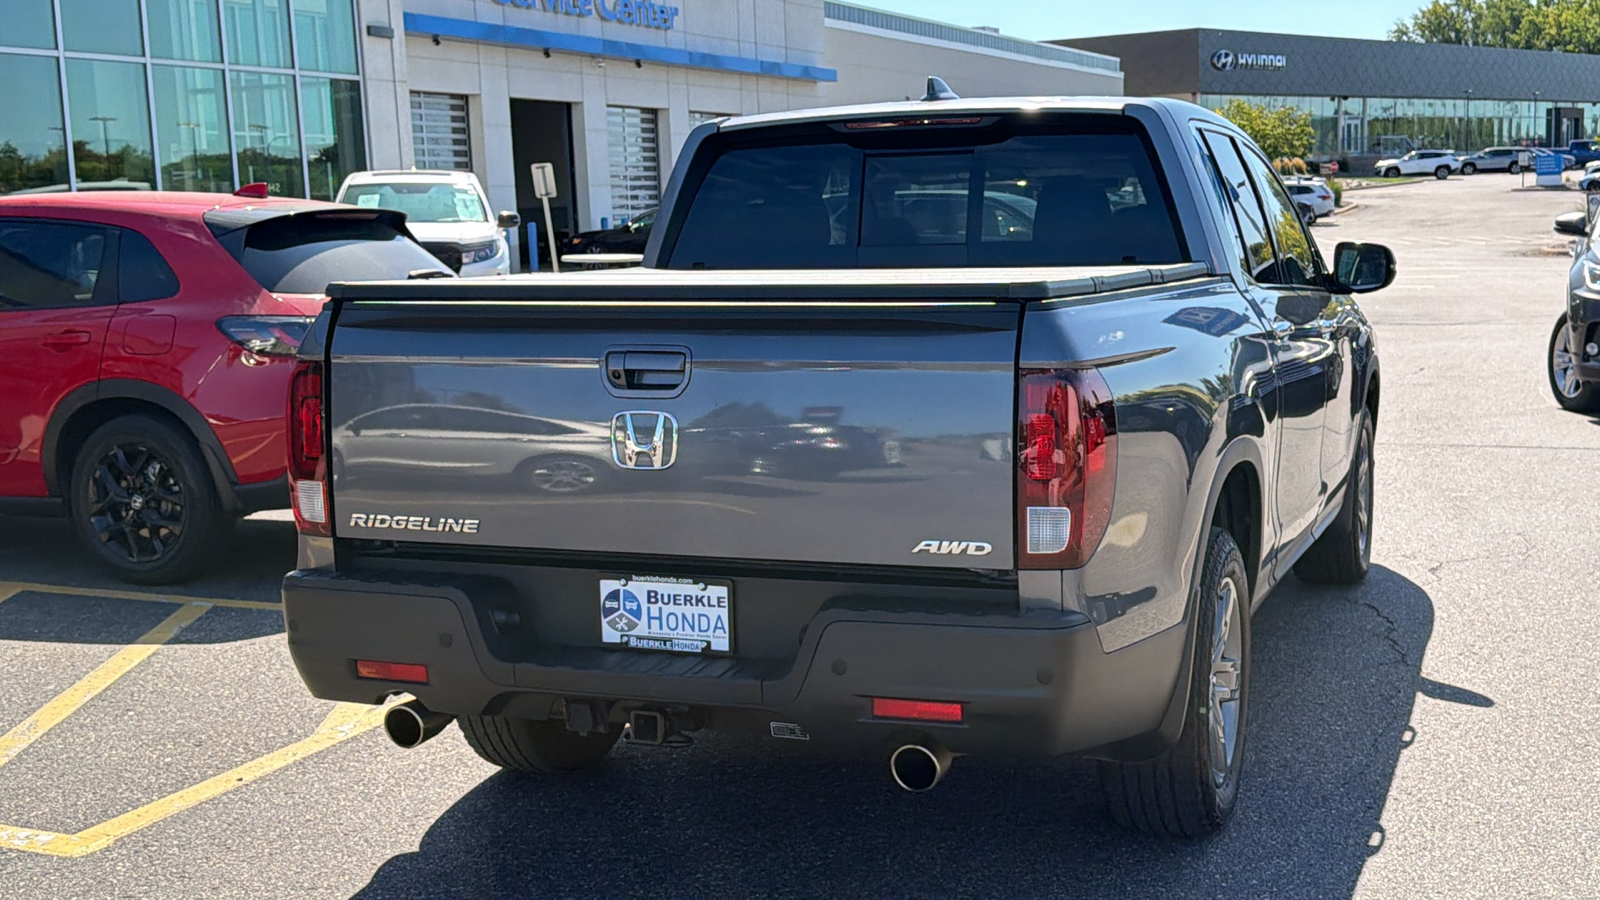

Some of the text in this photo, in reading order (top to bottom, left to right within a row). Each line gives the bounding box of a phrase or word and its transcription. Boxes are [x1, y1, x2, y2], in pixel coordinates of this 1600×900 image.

[600, 0, 679, 29] Center
[349, 513, 480, 533] RIDGELINE
[911, 540, 993, 556] AWD
[631, 574, 694, 584] buerklehonda.com
[646, 589, 727, 609] BUERKLE
[646, 606, 728, 635] HONDA
[629, 636, 700, 651] BUERKLE HONDA
